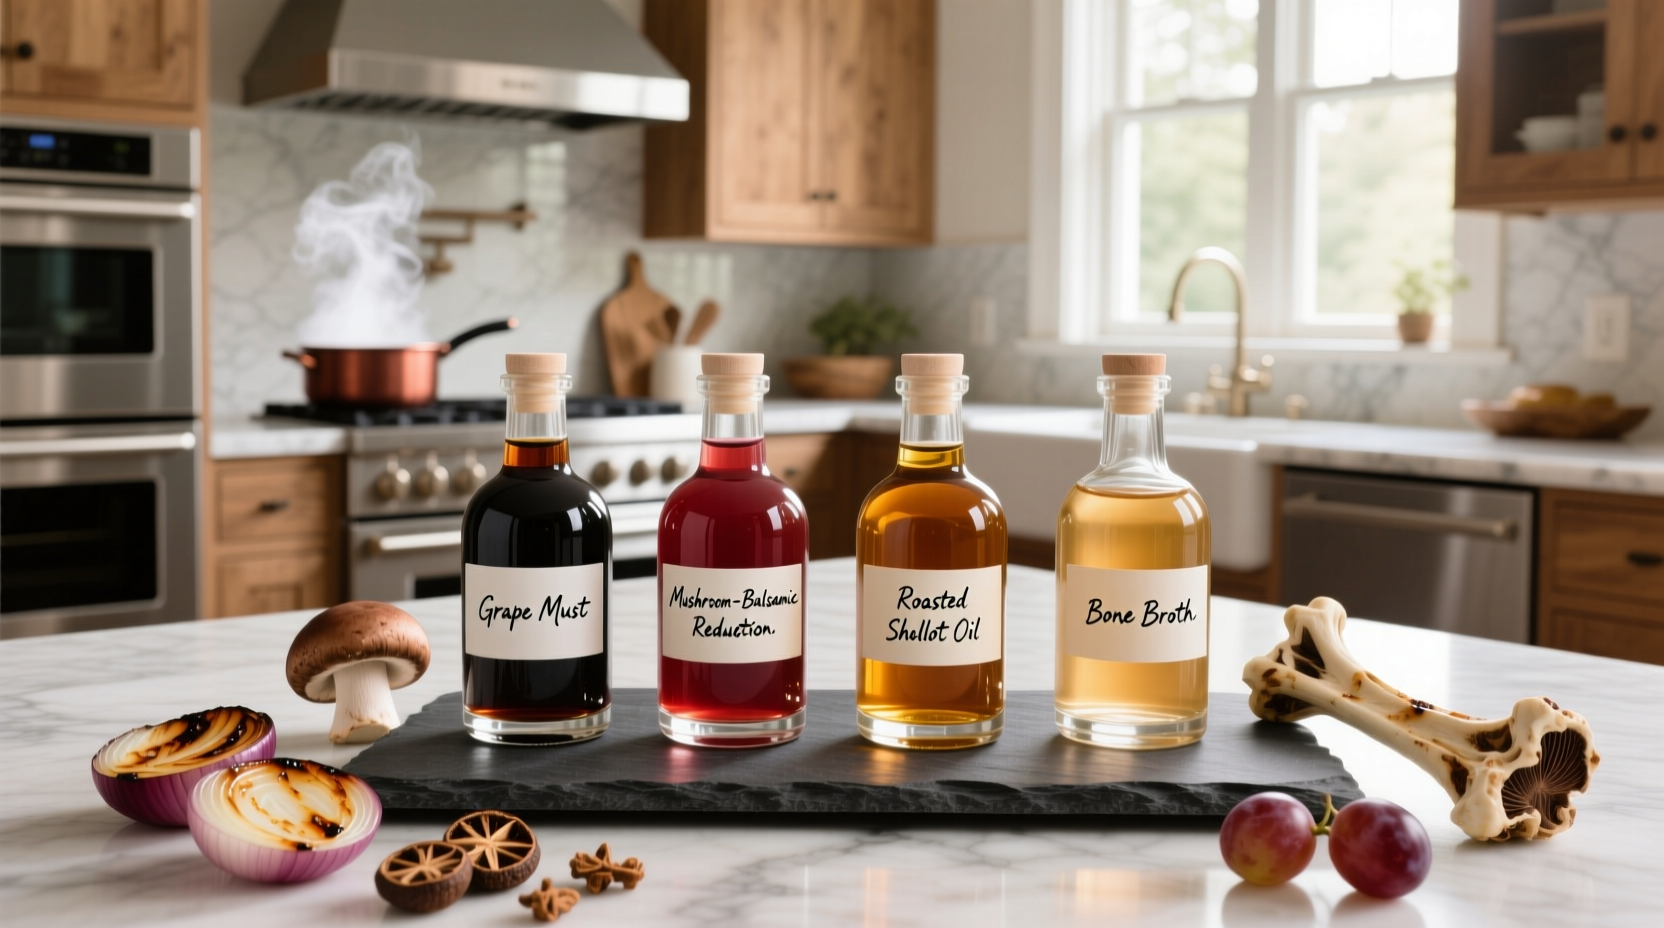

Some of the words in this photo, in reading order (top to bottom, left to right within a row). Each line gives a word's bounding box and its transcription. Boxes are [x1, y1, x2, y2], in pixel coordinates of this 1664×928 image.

[668, 585, 799, 610] Mushroom-Balsamic
[896, 585, 969, 611] Roasted
[478, 593, 533, 632] Grape
[538, 594, 592, 627] Must
[1085, 598, 1136, 626] Bone
[953, 616, 981, 643] Oil
